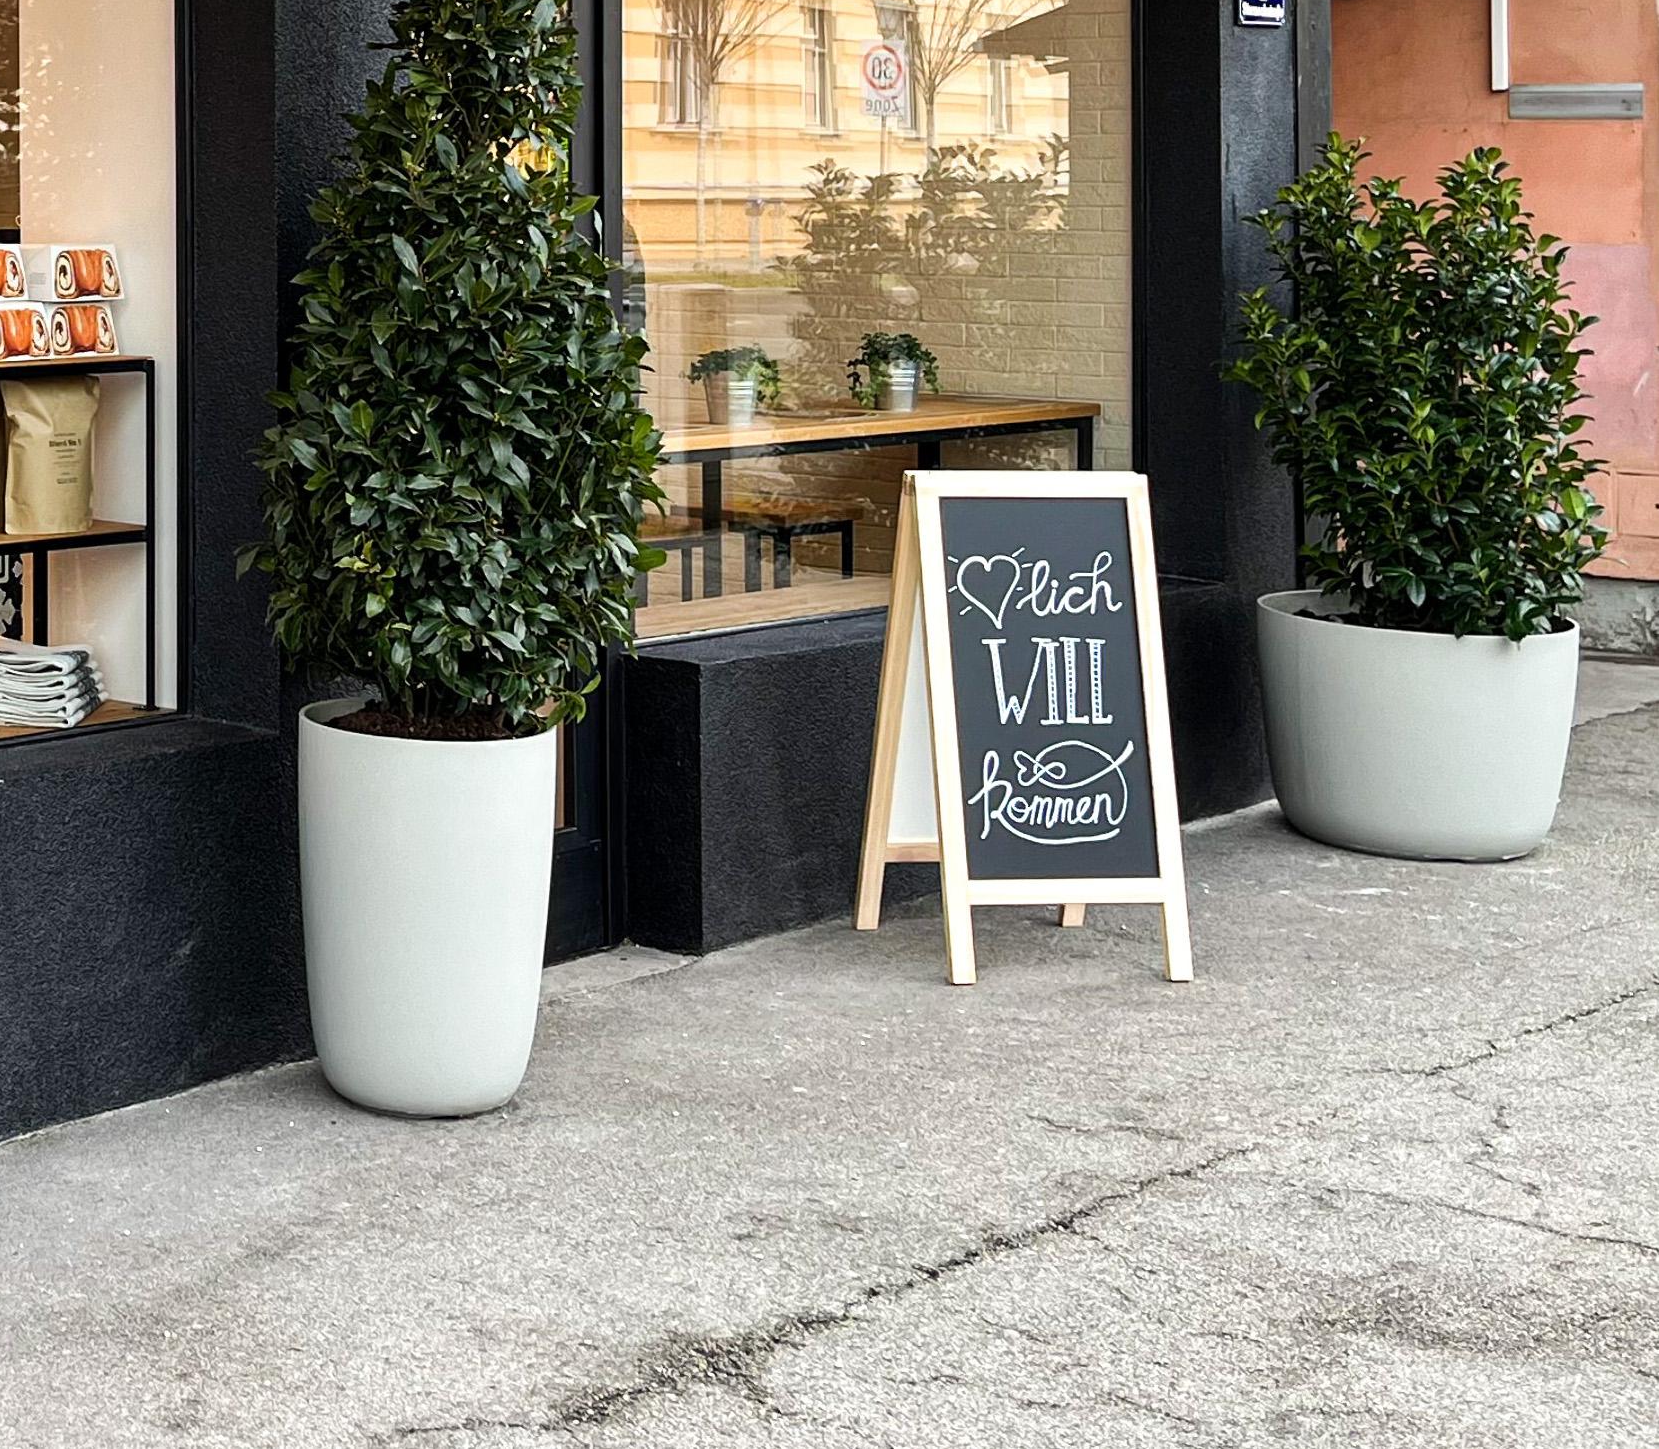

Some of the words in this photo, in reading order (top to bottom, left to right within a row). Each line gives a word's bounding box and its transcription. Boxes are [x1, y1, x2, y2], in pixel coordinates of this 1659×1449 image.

[1016, 551, 1122, 617] lich
[981, 636, 1113, 725] WILL
[967, 749, 1128, 844] kommen
